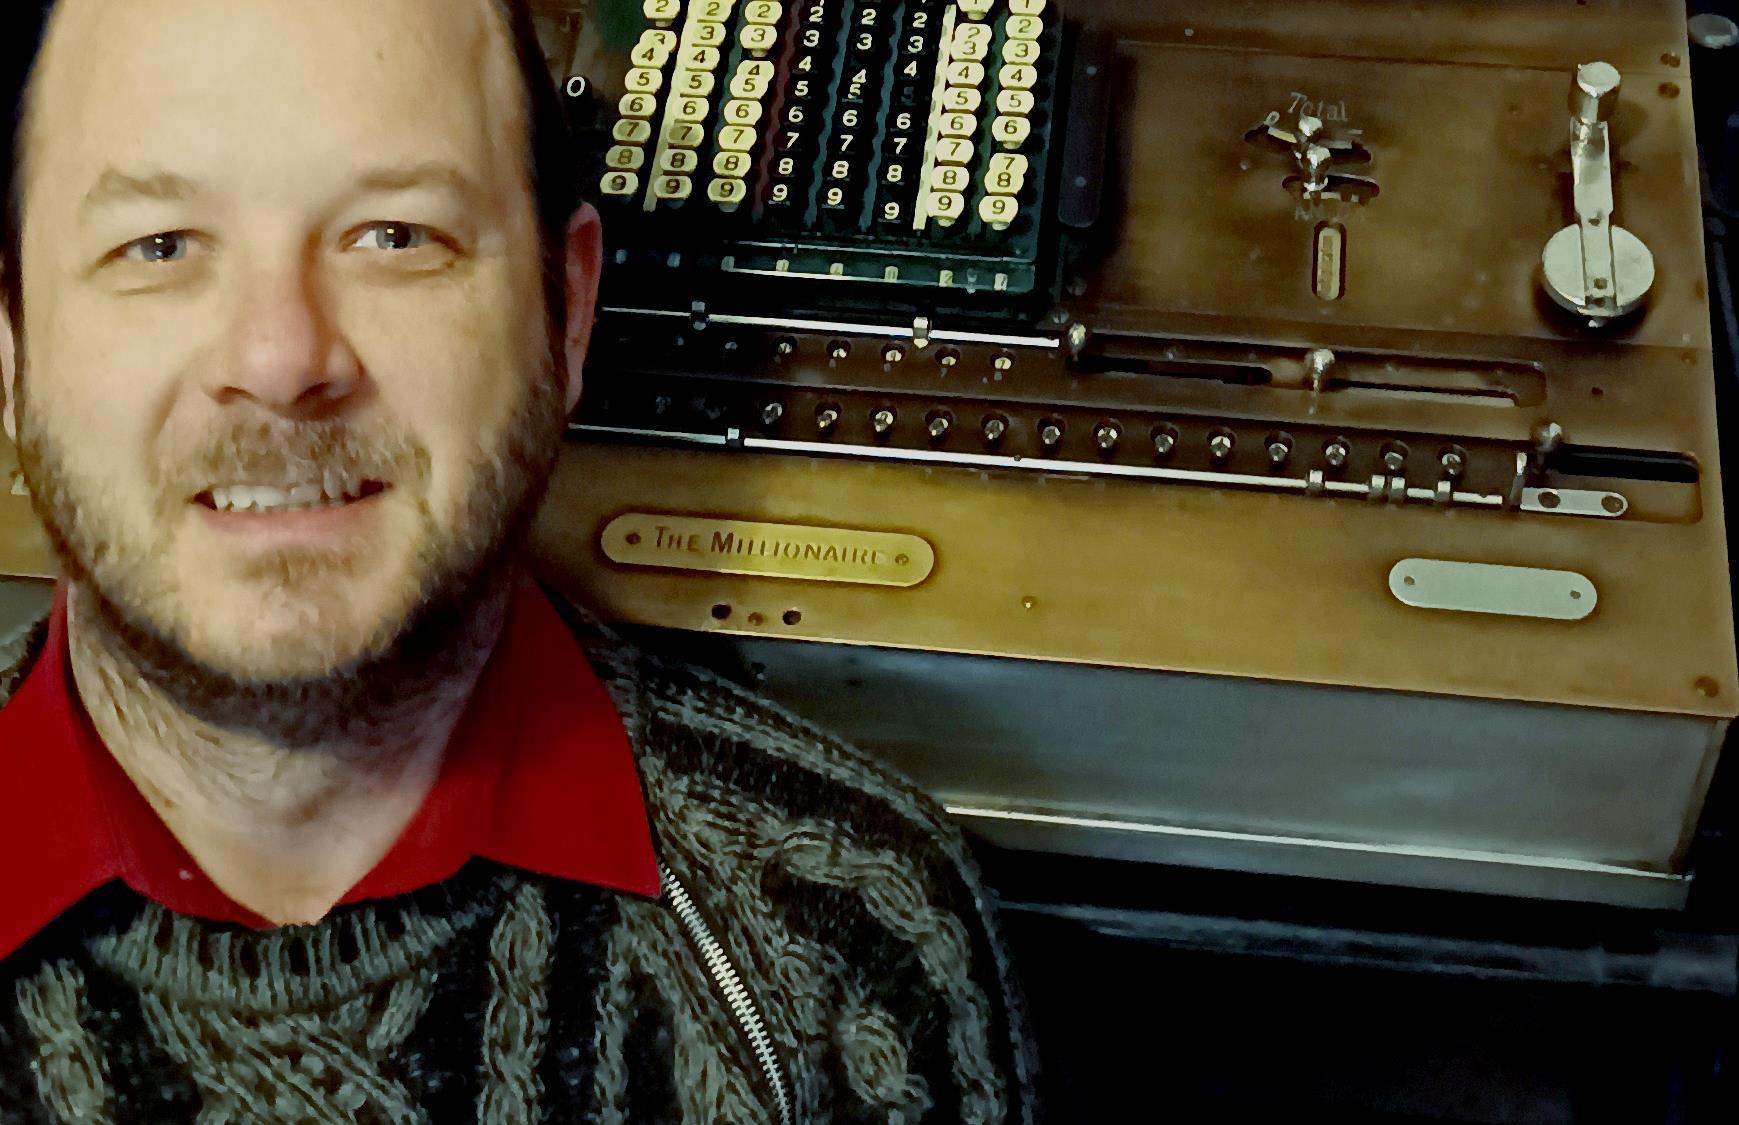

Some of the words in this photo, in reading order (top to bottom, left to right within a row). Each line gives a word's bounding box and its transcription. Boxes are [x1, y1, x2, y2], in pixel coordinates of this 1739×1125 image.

[656, 0, 669, 12] 2
[707, 1, 720, 16] 2
[757, 4, 771, 18] 2
[809, 6, 824, 22] 2
[862, 9, 876, 25] 2
[913, 12, 927, 28] 2
[701, 25, 715, 40] 3
[1018, 19, 1031, 33] 2
[751, 28, 765, 42] 3
[804, 30, 819, 47] 3
[856, 33, 873, 50] 3
[908, 36, 924, 52] 3
[962, 41, 976, 55] 3
[1015, 43, 1028, 58] 3
[641, 47, 655, 61] 4
[693, 50, 706, 64] 4
[748, 64, 760, 76] 4
[799, 56, 812, 72] 4
[904, 61, 917, 77] 4
[637, 72, 650, 86] 5
[852, 69, 866, 84] 4
[959, 65, 970, 79] 4
[1011, 69, 1022, 82] 4
[689, 75, 702, 89] 5
[742, 78, 756, 92] 5
[794, 80, 808, 96] 5
[630, 97, 644, 112] 6
[955, 91, 969, 105] 5
[1009, 94, 1021, 108] 5
[683, 100, 697, 115] 6
[736, 104, 749, 118] 6
[1286, 91, 1348, 121] Total
[789, 106, 803, 122] 6
[843, 110, 857, 126] 6
[897, 113, 911, 129] 6
[628, 122, 640, 137] 7
[951, 116, 964, 130] 6
[1004, 120, 1017, 134] 6
[679, 126, 692, 140] 7
[733, 129, 744, 143] 7
[787, 132, 799, 148] 7
[840, 135, 853, 152] 7
[894, 138, 907, 154] 7
[950, 142, 961, 156] 7
[618, 149, 633, 165] 8
[671, 152, 686, 168] 8
[724, 155, 739, 171] 8
[1004, 157, 1015, 170] 7
[778, 158, 794, 175] 8
[832, 161, 849, 178] 8
[887, 164, 902, 182] 8
[611, 175, 626, 190] 9
[943, 170, 957, 185] 8
[997, 172, 1011, 187] 8
[666, 178, 680, 194] 9
[720, 181, 734, 197] 9
[773, 184, 788, 201] 9
[827, 187, 843, 205] 9
[937, 195, 952, 211] 9
[885, 202, 900, 219] 9
[992, 199, 1006, 214] 9
